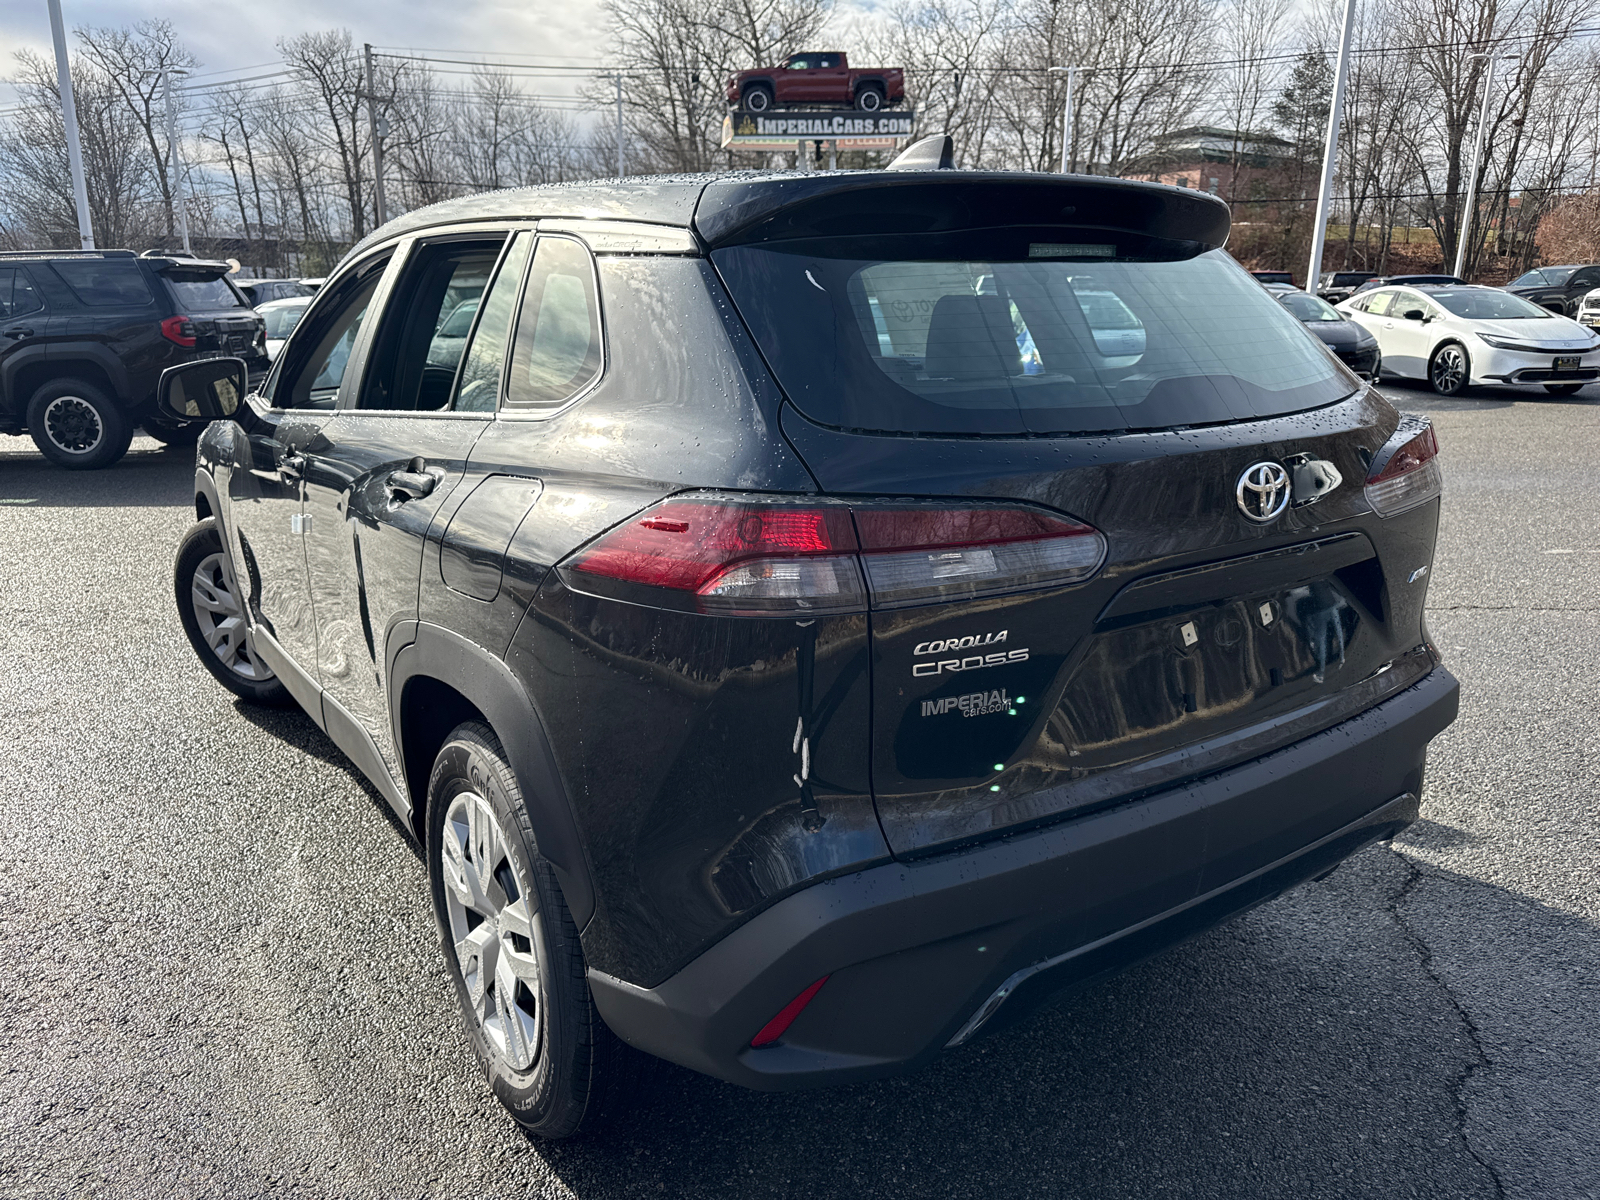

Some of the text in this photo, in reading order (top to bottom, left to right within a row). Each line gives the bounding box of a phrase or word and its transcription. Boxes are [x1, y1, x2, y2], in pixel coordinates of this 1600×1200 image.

[913, 629, 1008, 656] COROLLA
[912, 648, 1030, 677] CROSS
[921, 687, 1011, 717] IMPERIAL
[963, 701, 1012, 718] cars.com
